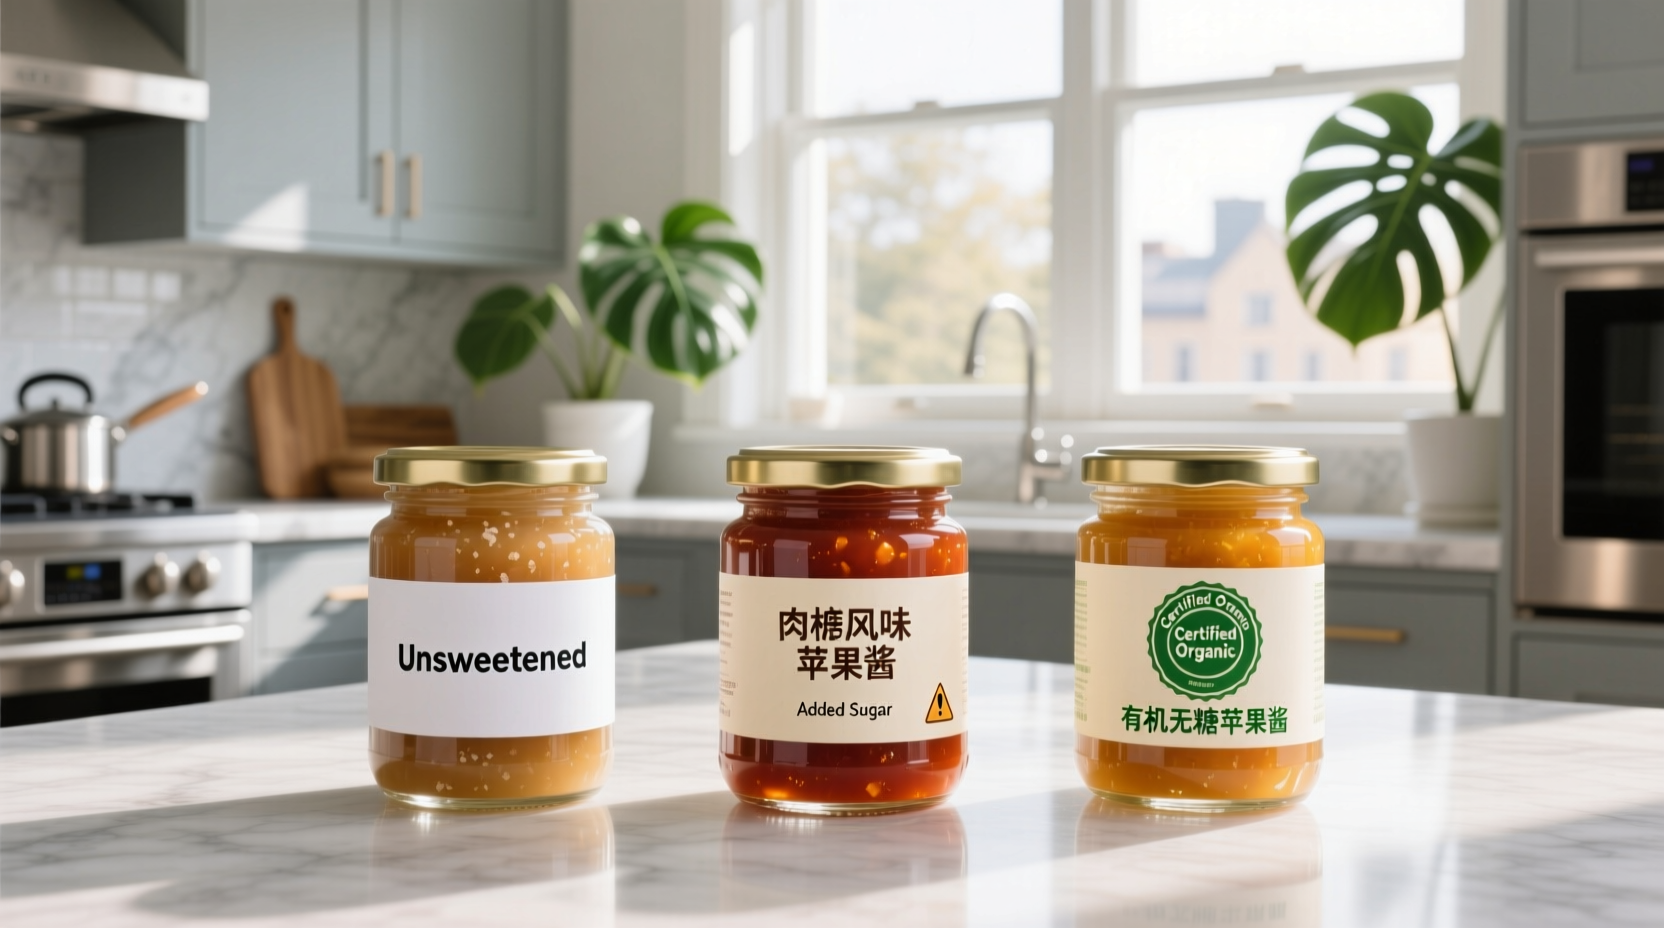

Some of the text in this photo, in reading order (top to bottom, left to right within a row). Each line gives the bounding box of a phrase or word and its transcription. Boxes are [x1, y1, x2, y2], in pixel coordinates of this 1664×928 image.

[1175, 625, 1237, 641] Certified
[399, 640, 587, 674] Unsweetened
[797, 644, 896, 680] 苹果酱
[1175, 642, 1236, 663] Organic
[797, 701, 892, 721] Added Sugar
[1121, 705, 1288, 735] 有机无糖苹果酱
